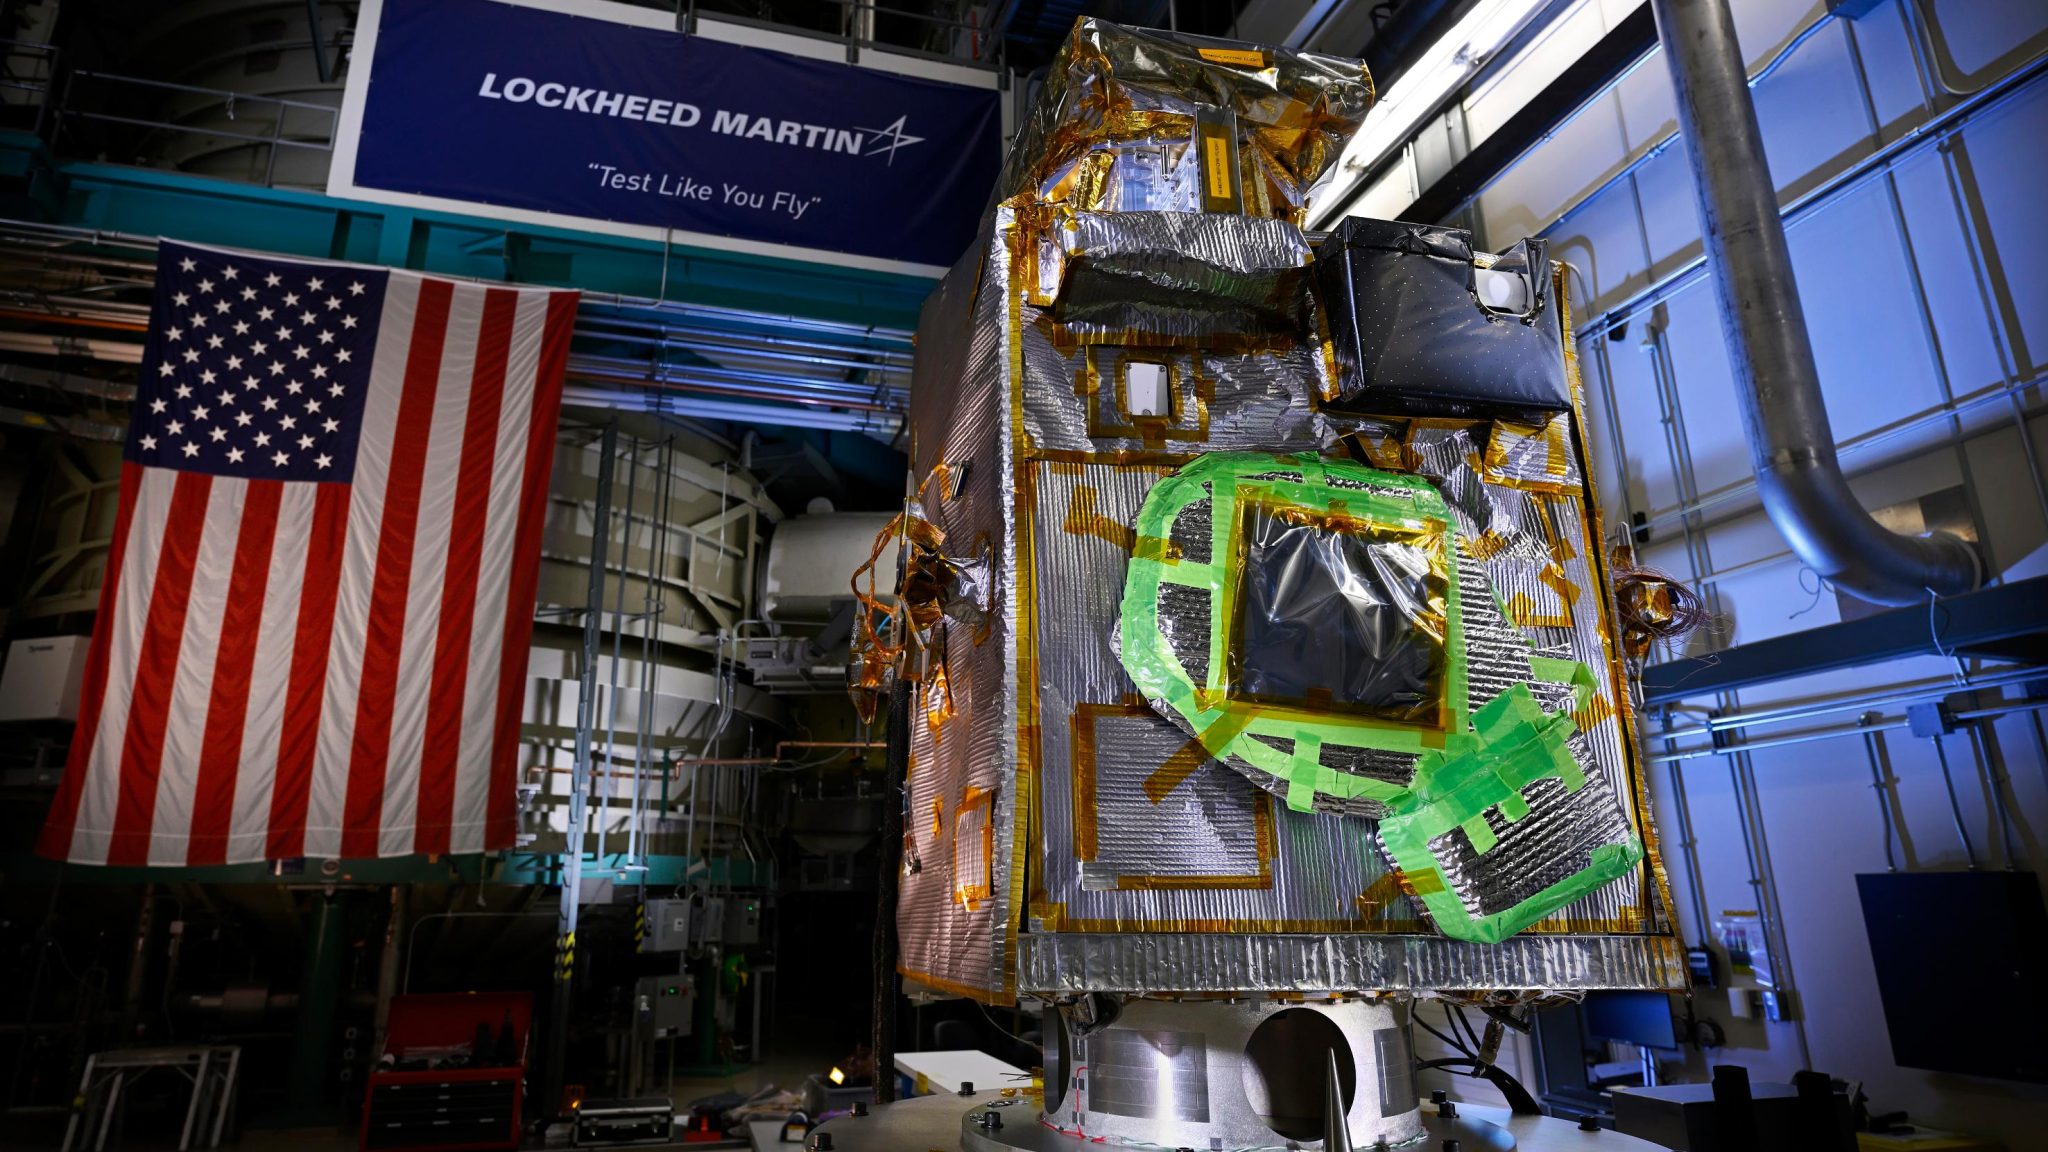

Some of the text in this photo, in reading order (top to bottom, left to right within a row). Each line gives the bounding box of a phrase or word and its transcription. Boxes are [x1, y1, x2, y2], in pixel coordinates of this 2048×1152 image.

[478, 72, 864, 155] LOCKHEED MARTIN
[588, 162, 822, 220] “Test Like You Fly”
